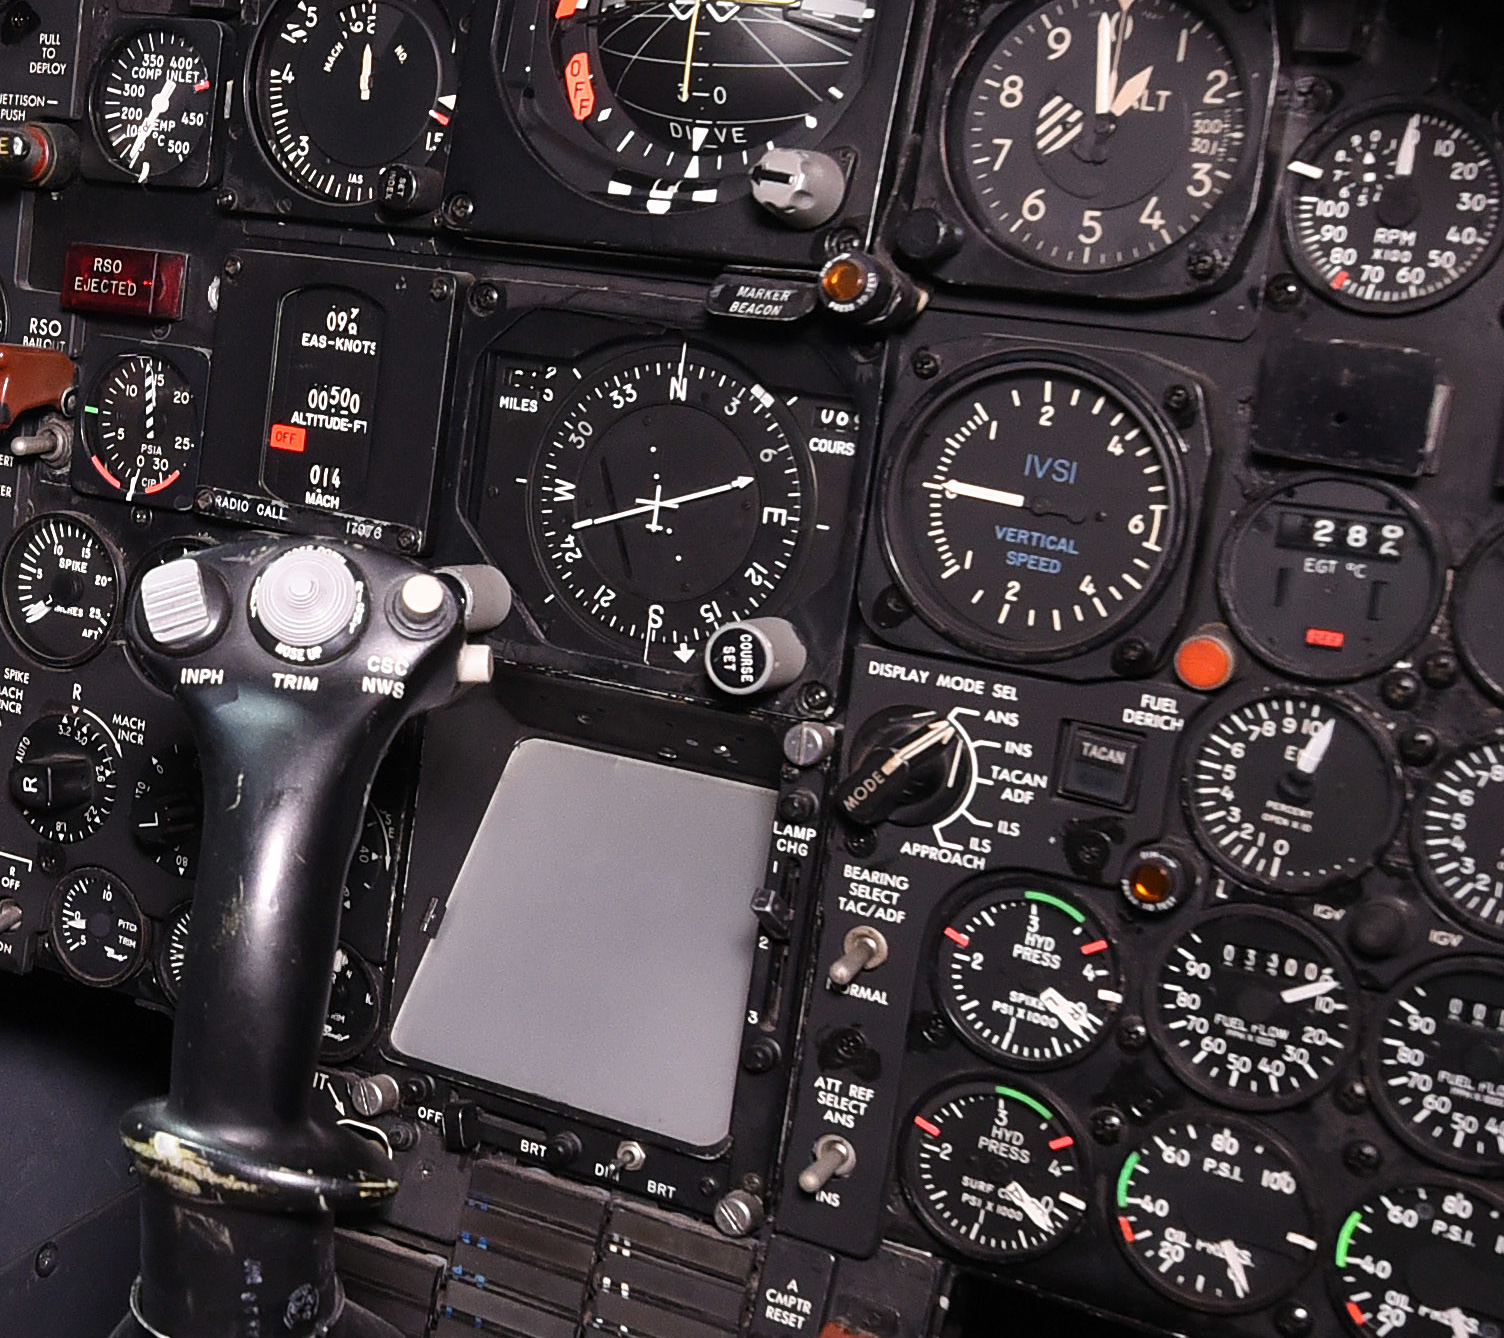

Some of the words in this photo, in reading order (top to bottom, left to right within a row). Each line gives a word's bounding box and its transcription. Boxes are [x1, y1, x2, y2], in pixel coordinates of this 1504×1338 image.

[40, 33, 60, 45] PULL
[42, 47, 55, 59] TO
[30, 62, 66, 75] DEPLOY
[132, 67, 162, 80] COMP
[166, 69, 200, 83] INLET
[1203, 69, 1228, 104] 2
[1, 109, 25, 121] PUSH
[1078, 211, 1102, 244] 5
[1374, 228, 1417, 246] RPM
[94, 258, 122, 273] RSO
[75, 277, 136, 296] EJECTED
[737, 286, 794, 301] MARKER
[729, 301, 783, 317] BEACON
[30, 318, 61, 336] RSO
[500, 396, 537, 412] MILES
[1024, 454, 1077, 484] IVSI
[215, 495, 249, 512] RADIO
[257, 500, 288, 520] CALL
[305, 491, 339, 509] MACH
[995, 526, 1079, 554] VERTICAL
[1006, 551, 1061, 573] SPEED
[1304, 558, 1338, 573] EGT
[364, 653, 411, 677] CSC
[181, 668, 224, 684] INPH
[272, 673, 318, 691] TRIM
[869, 661, 930, 683] DISPLAY
[936, 674, 985, 694] MODE
[992, 684, 1018, 701] SEL
[362, 676, 404, 698] NWS
[1141, 694, 1178, 714] FUEL
[984, 710, 1019, 727] ANS
[1123, 709, 1184, 730] DERICH
[1005, 741, 1032, 757] INS
[991, 765, 1048, 788] TACAN
[1001, 788, 1034, 804] ADF
[998, 820, 1020, 836] ILS
[900, 839, 985, 870] APPROACH
[844, 864, 909, 890] BEARING
[849, 883, 900, 905] SELECT
[839, 897, 906, 923] TAC/ADF
[814, 1076, 842, 1093] ATT
[849, 1084, 874, 1101] REF
[521, 1139, 547, 1157] BRT
[766, 1289, 811, 1320] CMPTR
[766, 1305, 805, 1329] RESET
